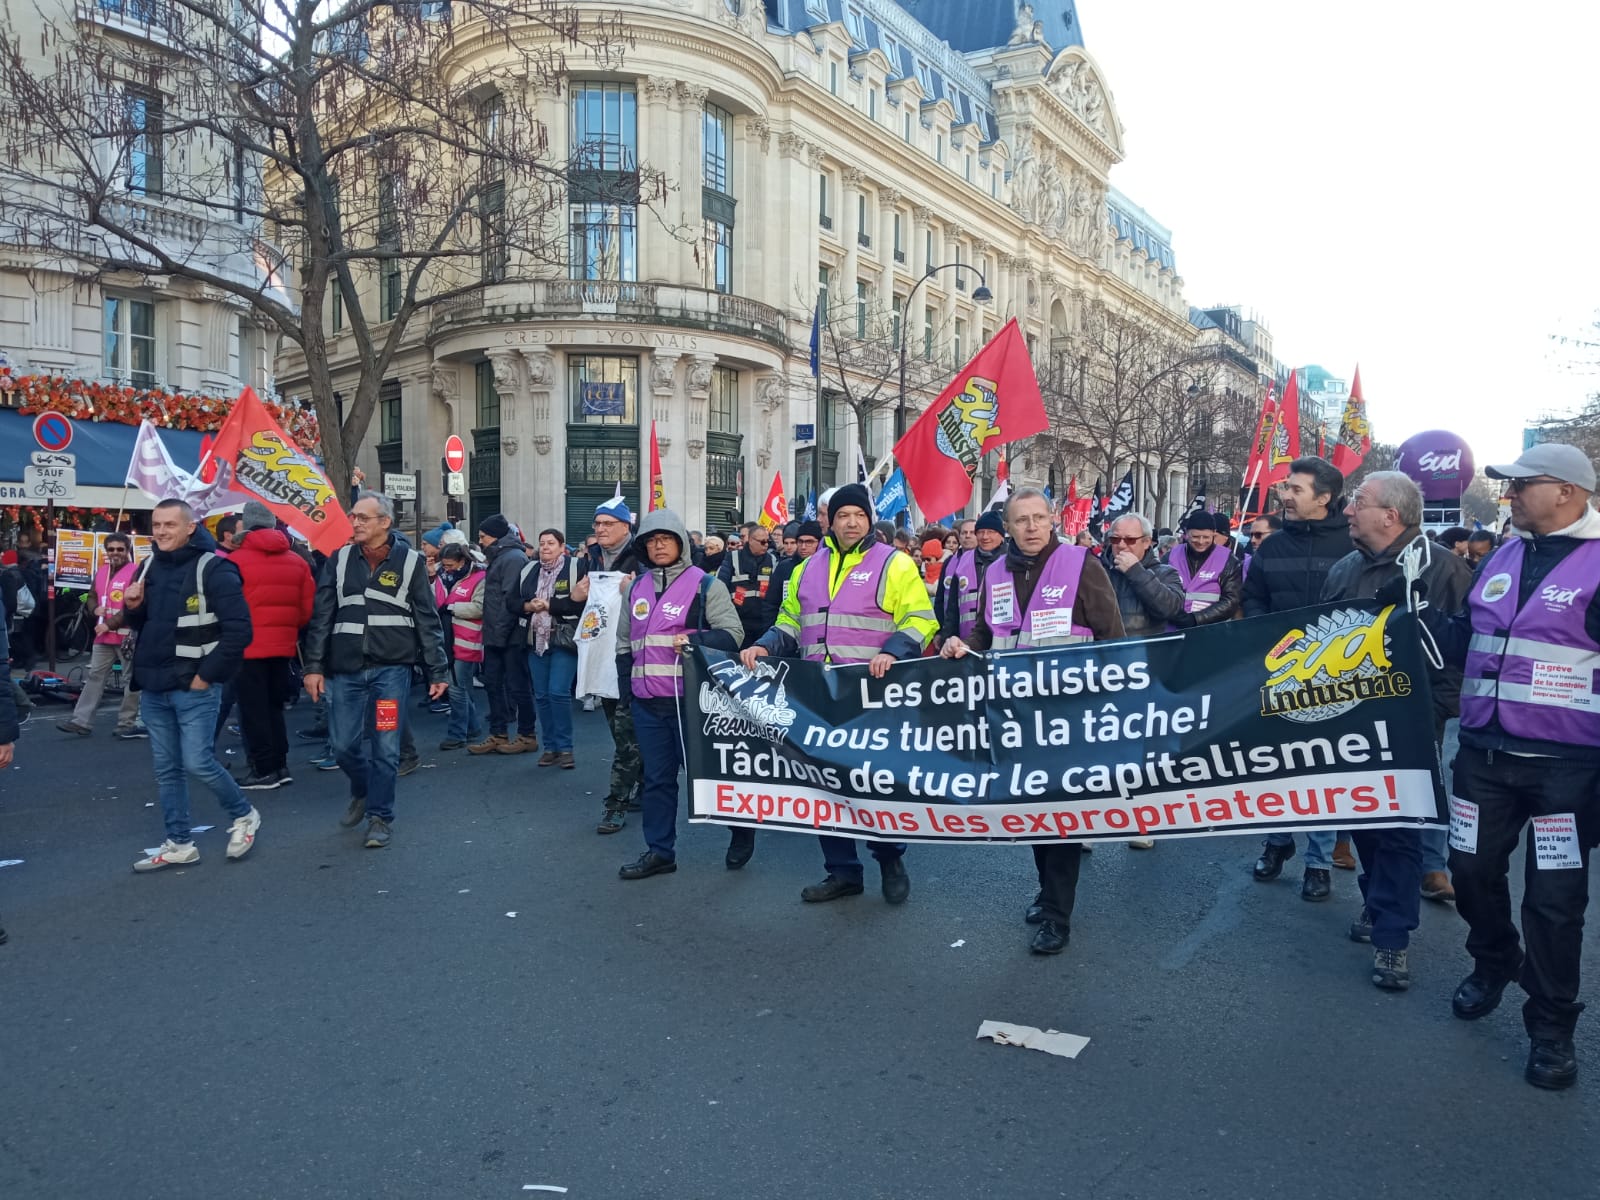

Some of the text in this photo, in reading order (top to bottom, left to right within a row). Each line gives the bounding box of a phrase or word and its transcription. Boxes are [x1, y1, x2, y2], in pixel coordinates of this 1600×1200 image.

[503, 330, 697, 350] CREDIT LYONNAIS
[37, 468, 65, 477] SAUF
[60, 566, 87, 574] MEETING
[1264, 603, 1397, 687] Sud
[1546, 665, 1573, 673] grève
[860, 658, 1151, 711] Les capitalistes
[1259, 665, 1412, 717] Industrie
[803, 724, 890, 752] nous
[900, 715, 991, 753] tuent
[1001, 708, 1023, 749] à
[1034, 709, 1071, 749] la
[713, 741, 842, 791] Tâchons
[849, 761, 896, 796] de
[908, 765, 1000, 800] tuer
[1009, 763, 1048, 797] le
[715, 784, 920, 834] Exproprions
[926, 807, 990, 835] les
